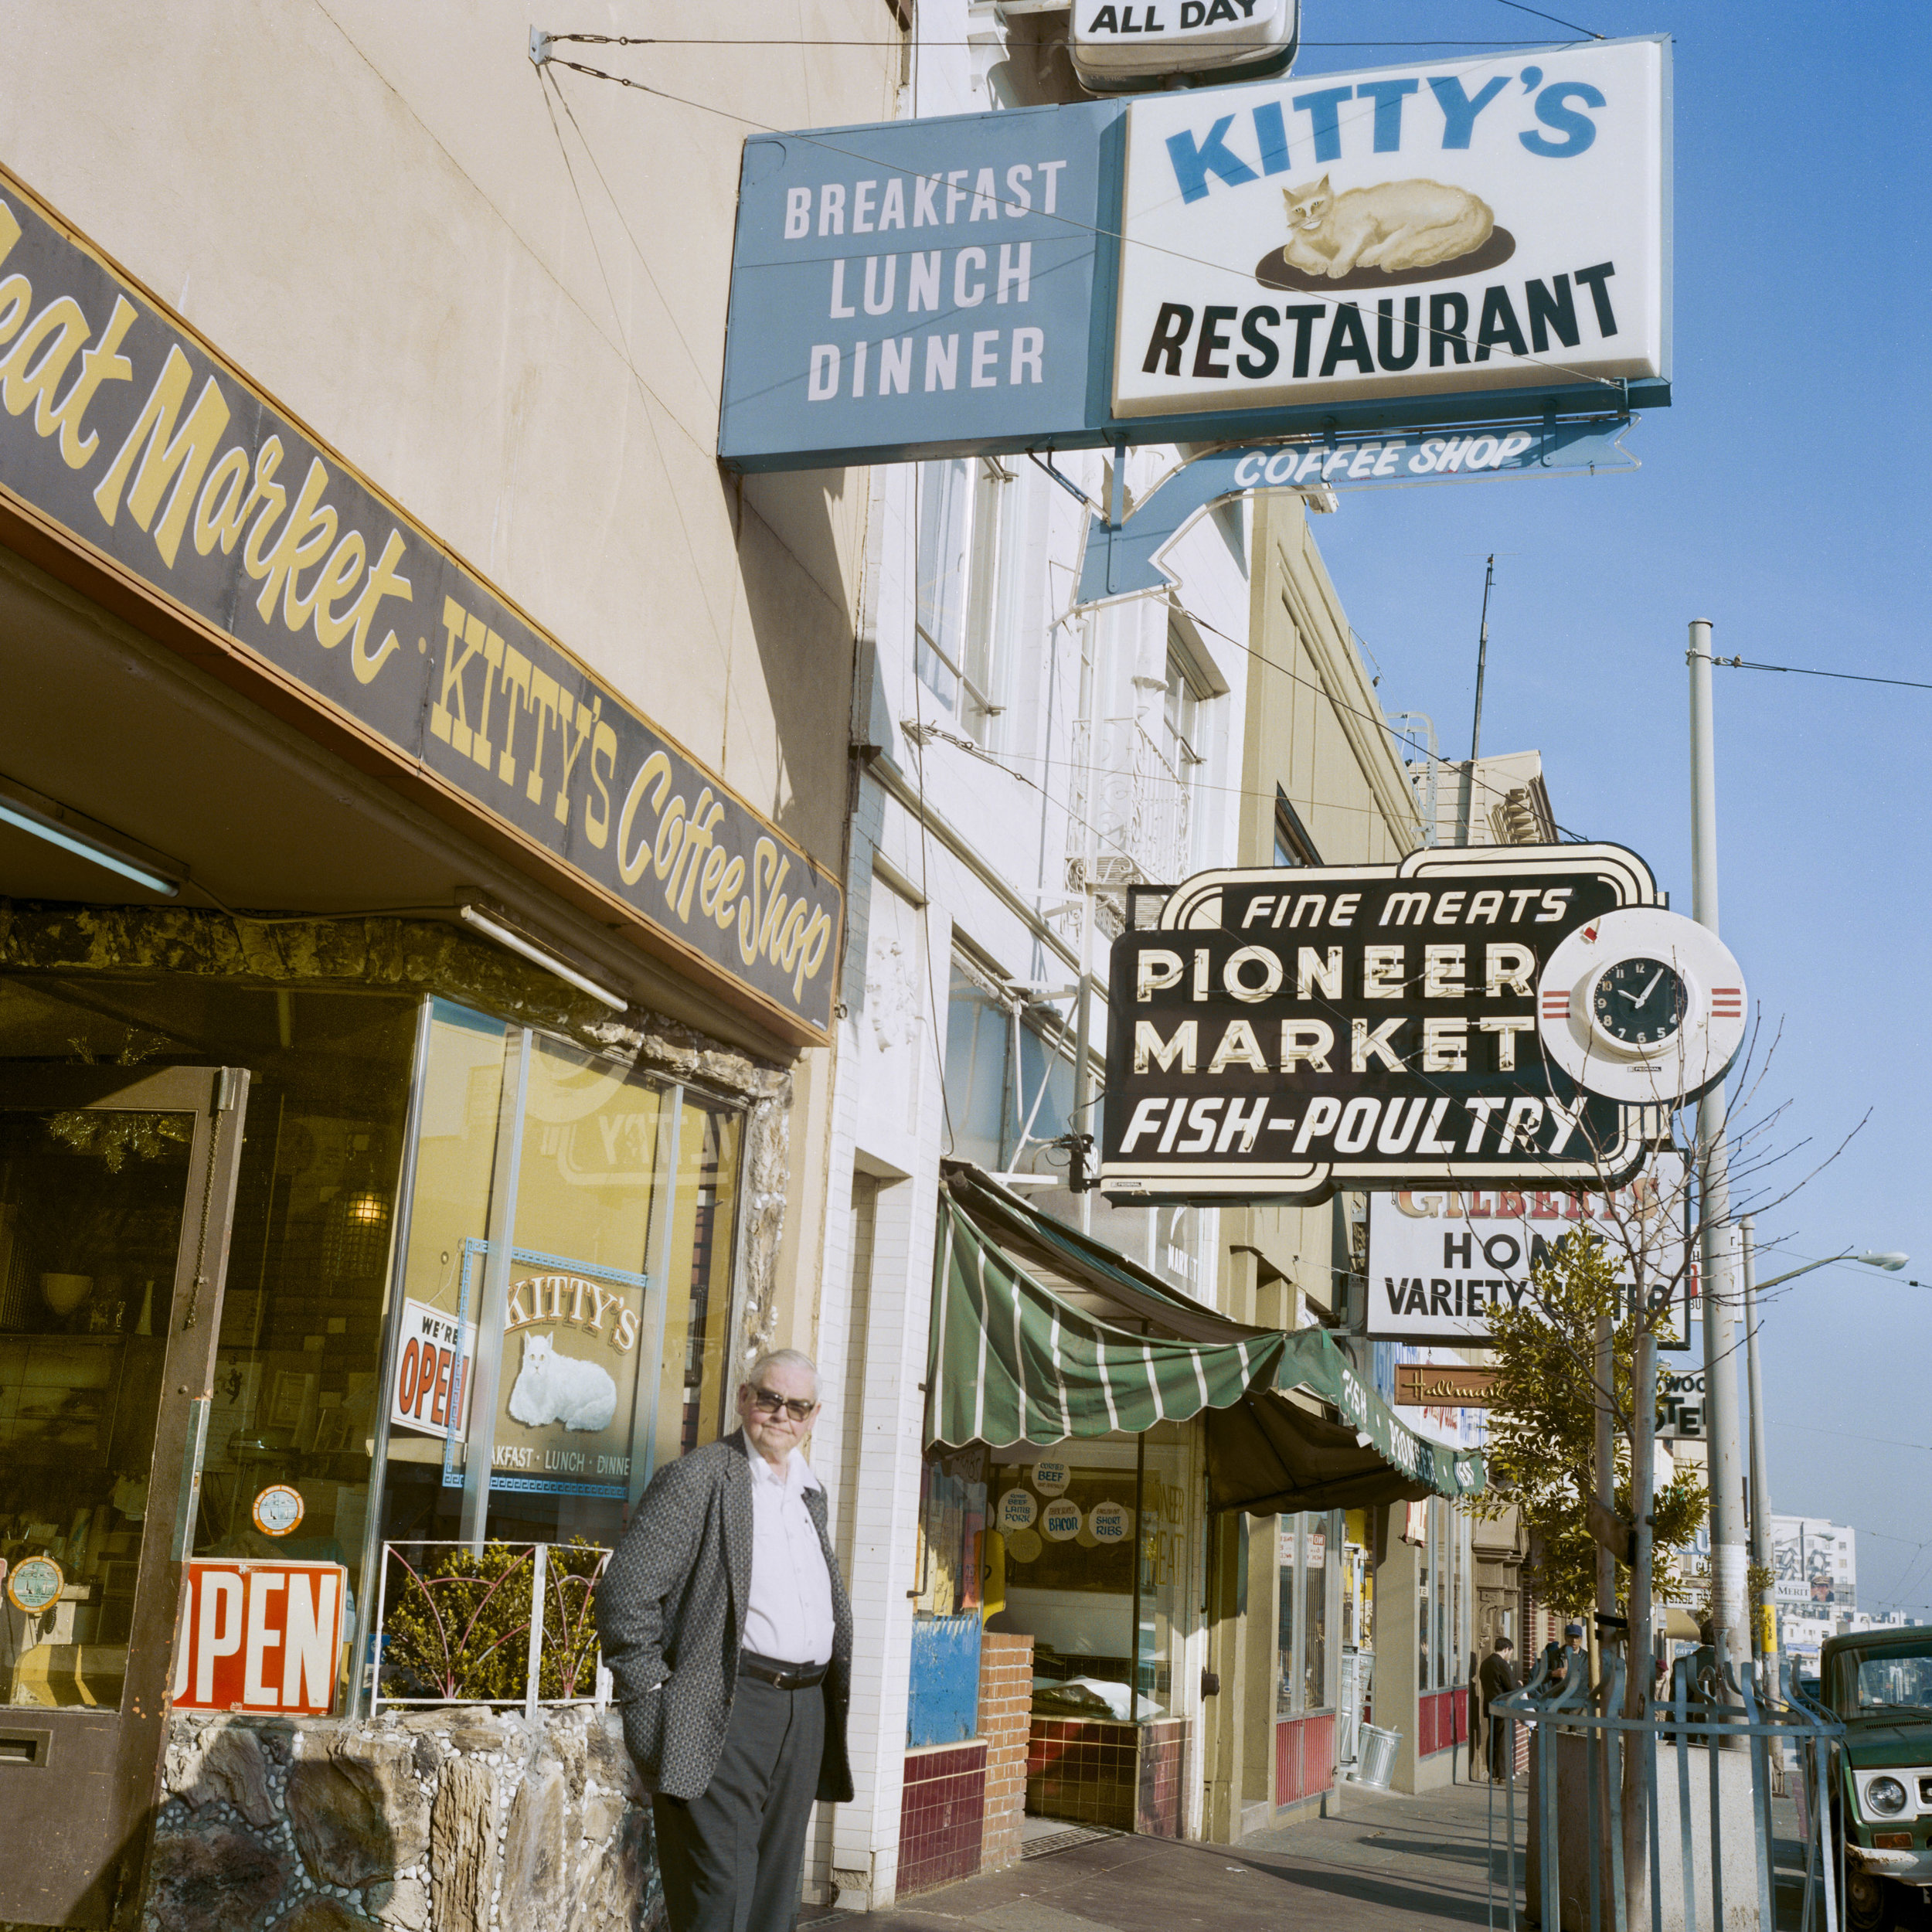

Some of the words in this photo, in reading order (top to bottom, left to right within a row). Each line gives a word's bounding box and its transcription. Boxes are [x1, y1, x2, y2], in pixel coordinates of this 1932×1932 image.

[1088, 5, 1165, 33] ALL
[1180, 0, 1258, 29] DAY
[1165, 66, 1607, 205] KITTY'S
[784, 160, 1067, 240] BREAKFAST
[830, 242, 1032, 319] LUNCH
[1141, 261, 1618, 381] RESTAURANT
[808, 327, 1045, 401] DINNER
[0, 199, 138, 469] eat
[94, 344, 413, 684] Market
[1234, 440, 1406, 488] COFFEE
[1408, 430, 1532, 474] SHOP
[430, 594, 617, 849] KITTY'S
[618, 750, 745, 929] Coffee
[739, 837, 831, 1004] Shop
[1242, 893, 1362, 929] FINE
[1379, 888, 1574, 927] MEATS
[1137, 943, 1536, 1002] PIONEER
[1133, 1016, 1535, 1075] MARKET
[1120, 1097, 1588, 1155] FISH-POULTRY
[505, 1275, 641, 1352] KITTY'S
[1385, 1277, 1528, 1316] VARIETY
[422, 1315, 458, 1345] WE'RE
[399, 1336, 470, 1431] OPEN
[1342, 1369, 1367, 1424] FISH
[545, 1449, 585, 1472] LUNCH
[1038, 1471, 1063, 1481] BEEF
[1389, 1418, 1438, 1484] PIONEER
[1005, 1513, 1030, 1523] PORK
[1049, 1516, 1079, 1532] BACON
[1096, 1515, 1121, 1525] SHORT
[1096, 1526, 1122, 1536] RIBS
